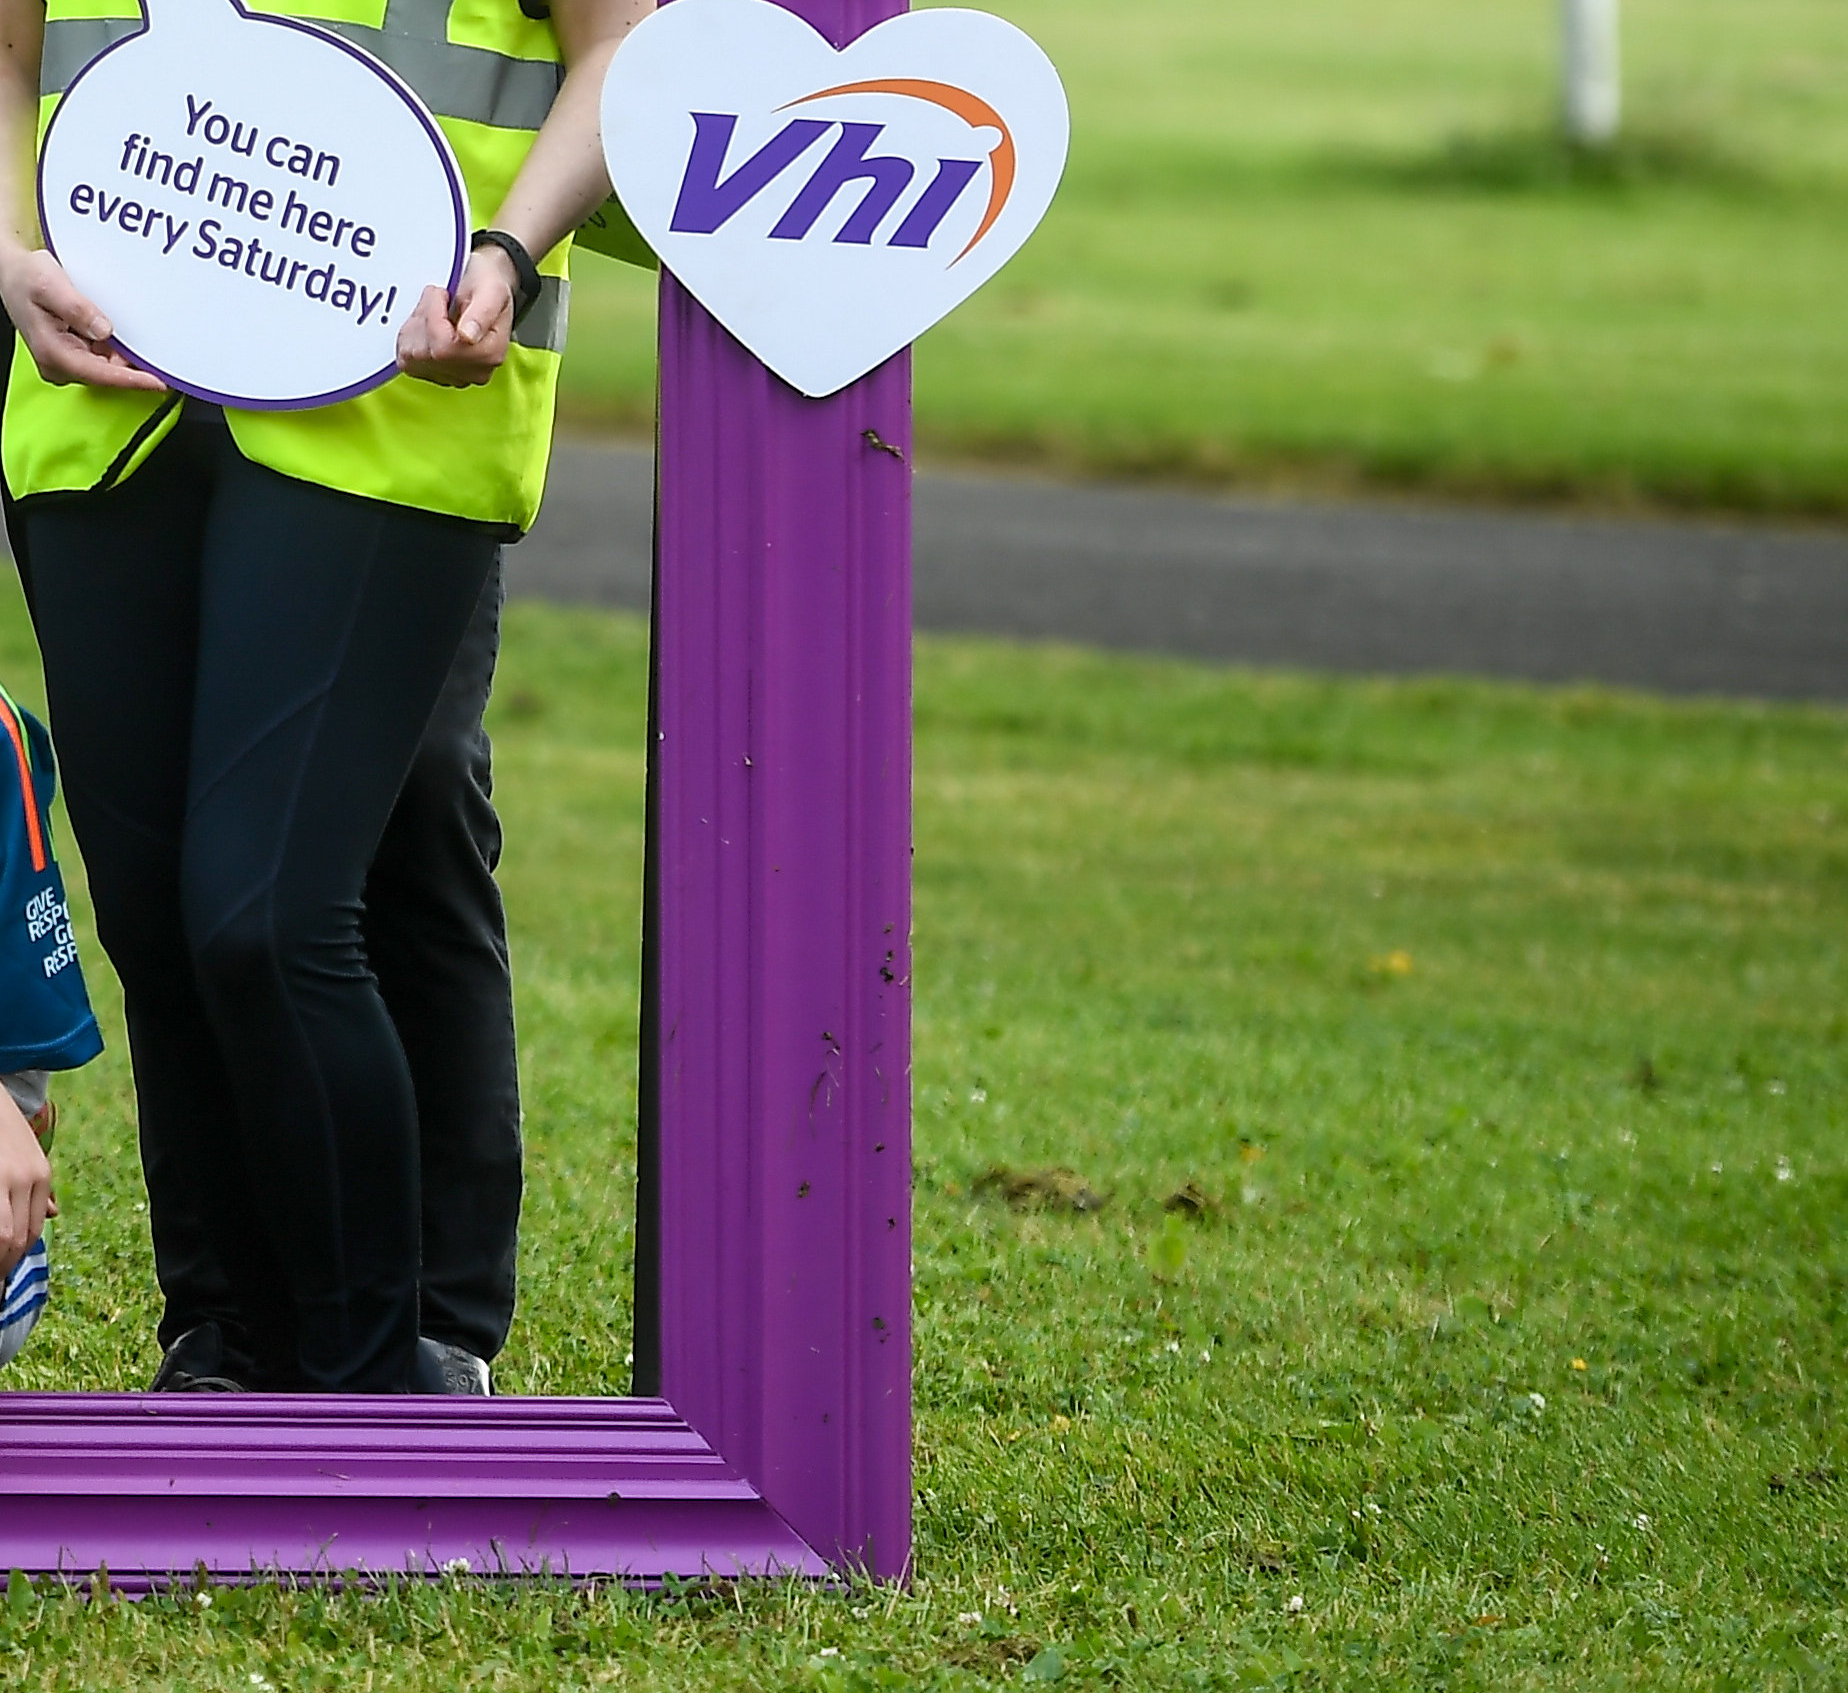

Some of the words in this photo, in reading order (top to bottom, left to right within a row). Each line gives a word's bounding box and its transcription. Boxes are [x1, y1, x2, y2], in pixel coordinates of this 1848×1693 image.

[120, 133, 203, 195] find
[207, 173, 274, 220] me
[280, 190, 376, 257] here
[186, 94, 258, 157] You
[265, 136, 341, 186] can
[669, 111, 986, 249] Vhi
[69, 183, 189, 254] every
[192, 219, 397, 325] Saturday!
[26, 886, 56, 921] GIVE
